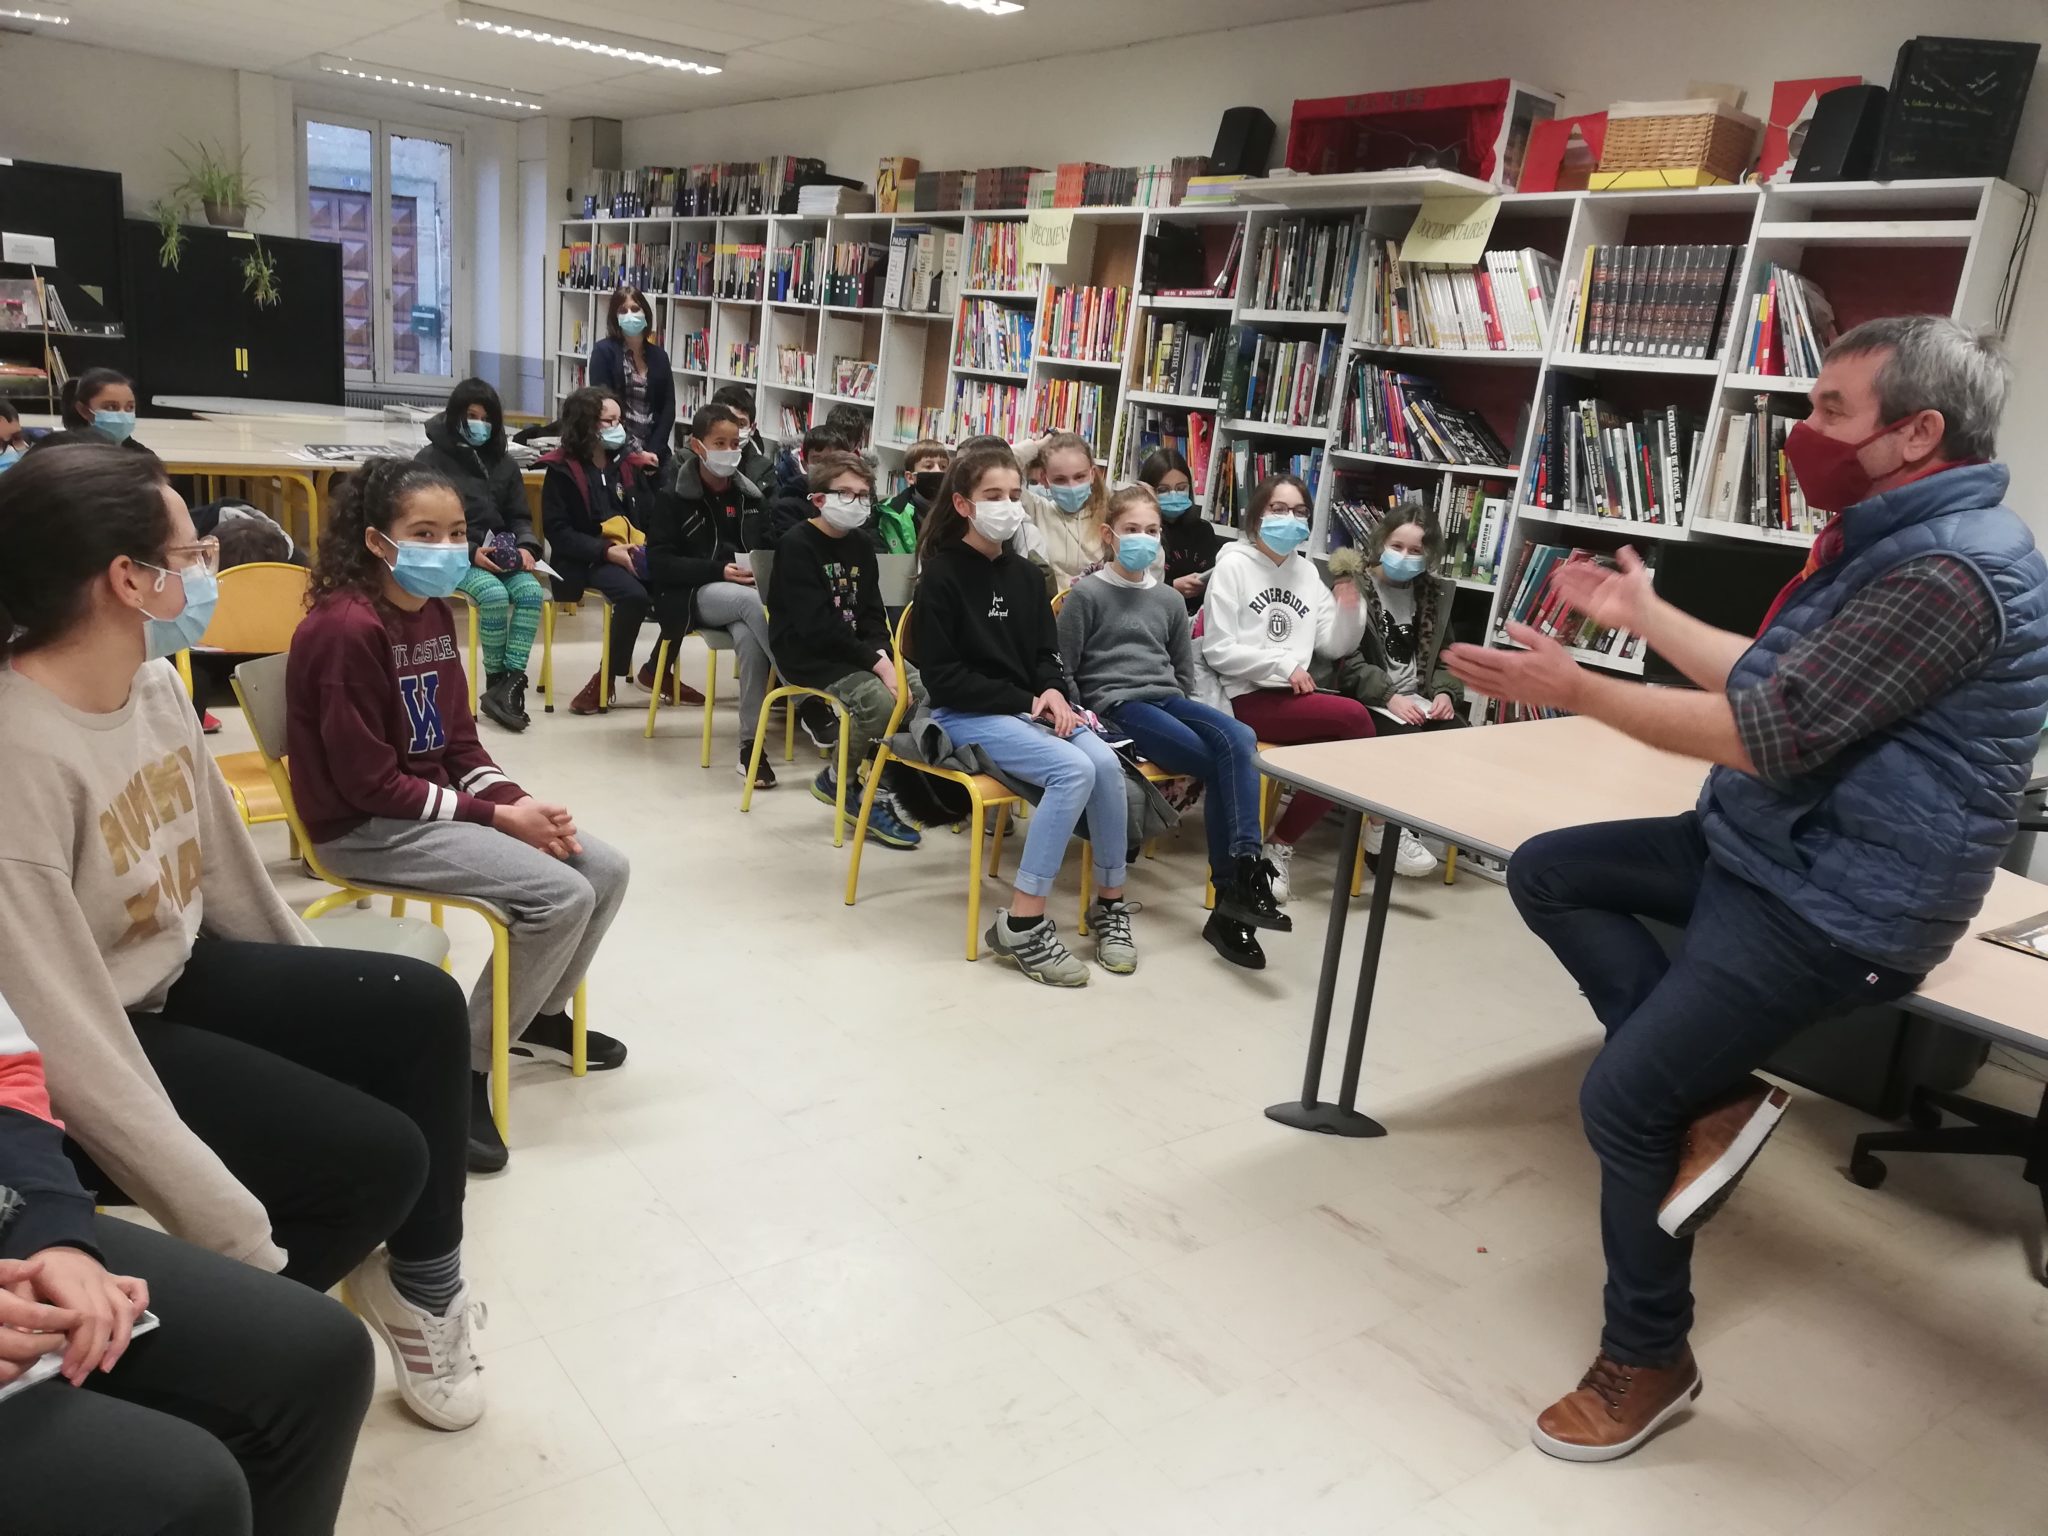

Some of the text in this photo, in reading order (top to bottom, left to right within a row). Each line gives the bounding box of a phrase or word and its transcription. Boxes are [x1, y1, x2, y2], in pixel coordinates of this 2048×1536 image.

[1416, 217, 1490, 241] DOCUMENTAIRES
[1172, 338, 1182, 369] BIBLE
[1671, 467, 1681, 499] FRANCE
[1248, 587, 1311, 619] RIVERSIDE
[412, 634, 456, 665] CSTLE
